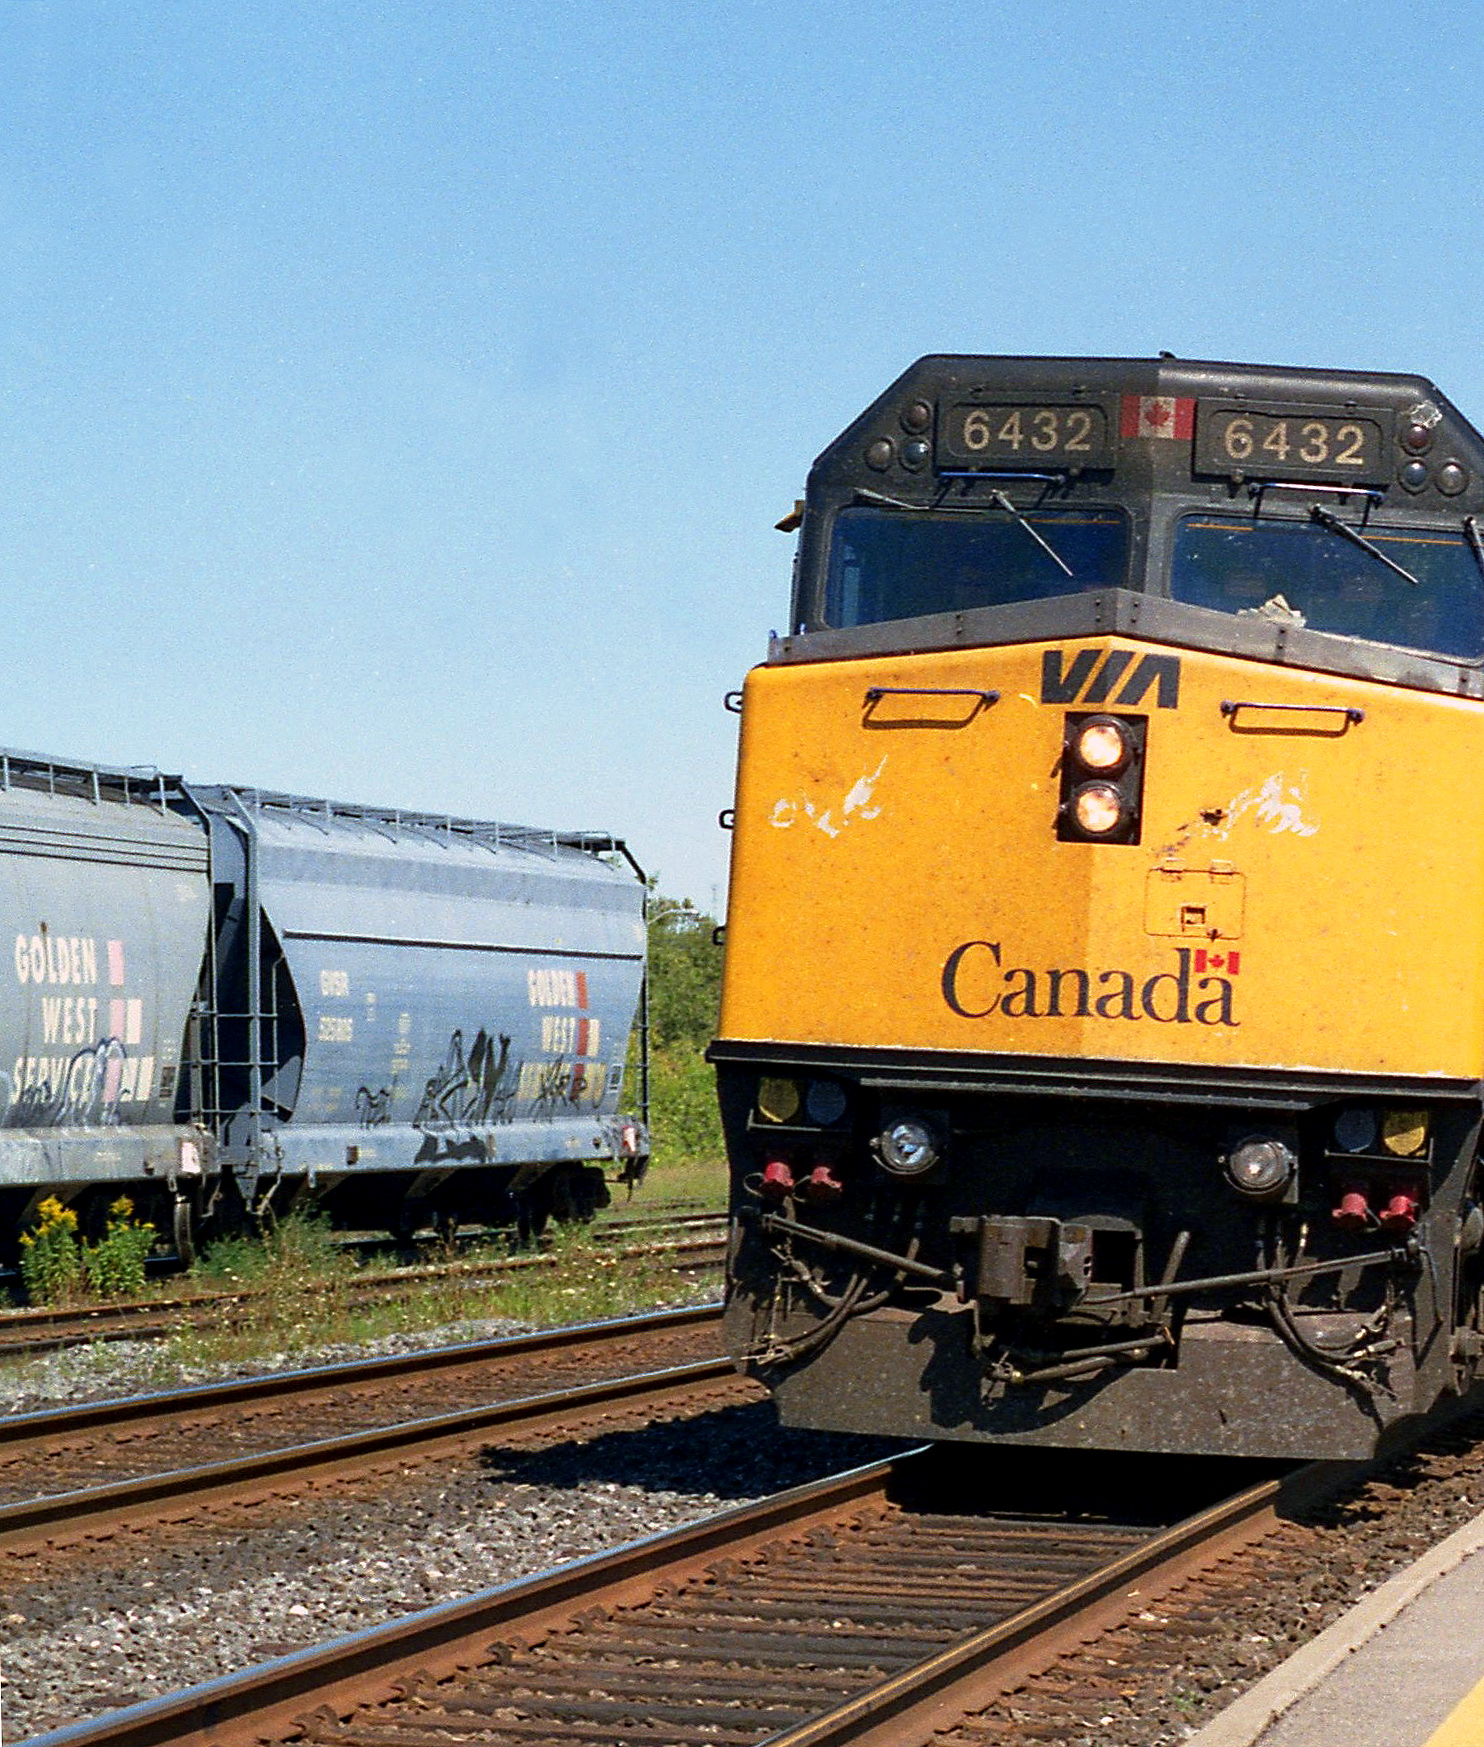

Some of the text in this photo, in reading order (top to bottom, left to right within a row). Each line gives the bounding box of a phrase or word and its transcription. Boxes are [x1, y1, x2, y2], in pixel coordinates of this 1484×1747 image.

[962, 409, 1092, 451] 6432
[1224, 418, 1365, 466] 6432
[1040, 648, 1182, 710] VIA
[15, 934, 98, 985] GOLDEN
[940, 940, 1242, 1028] Canada
[42, 998, 98, 1044] WEST
